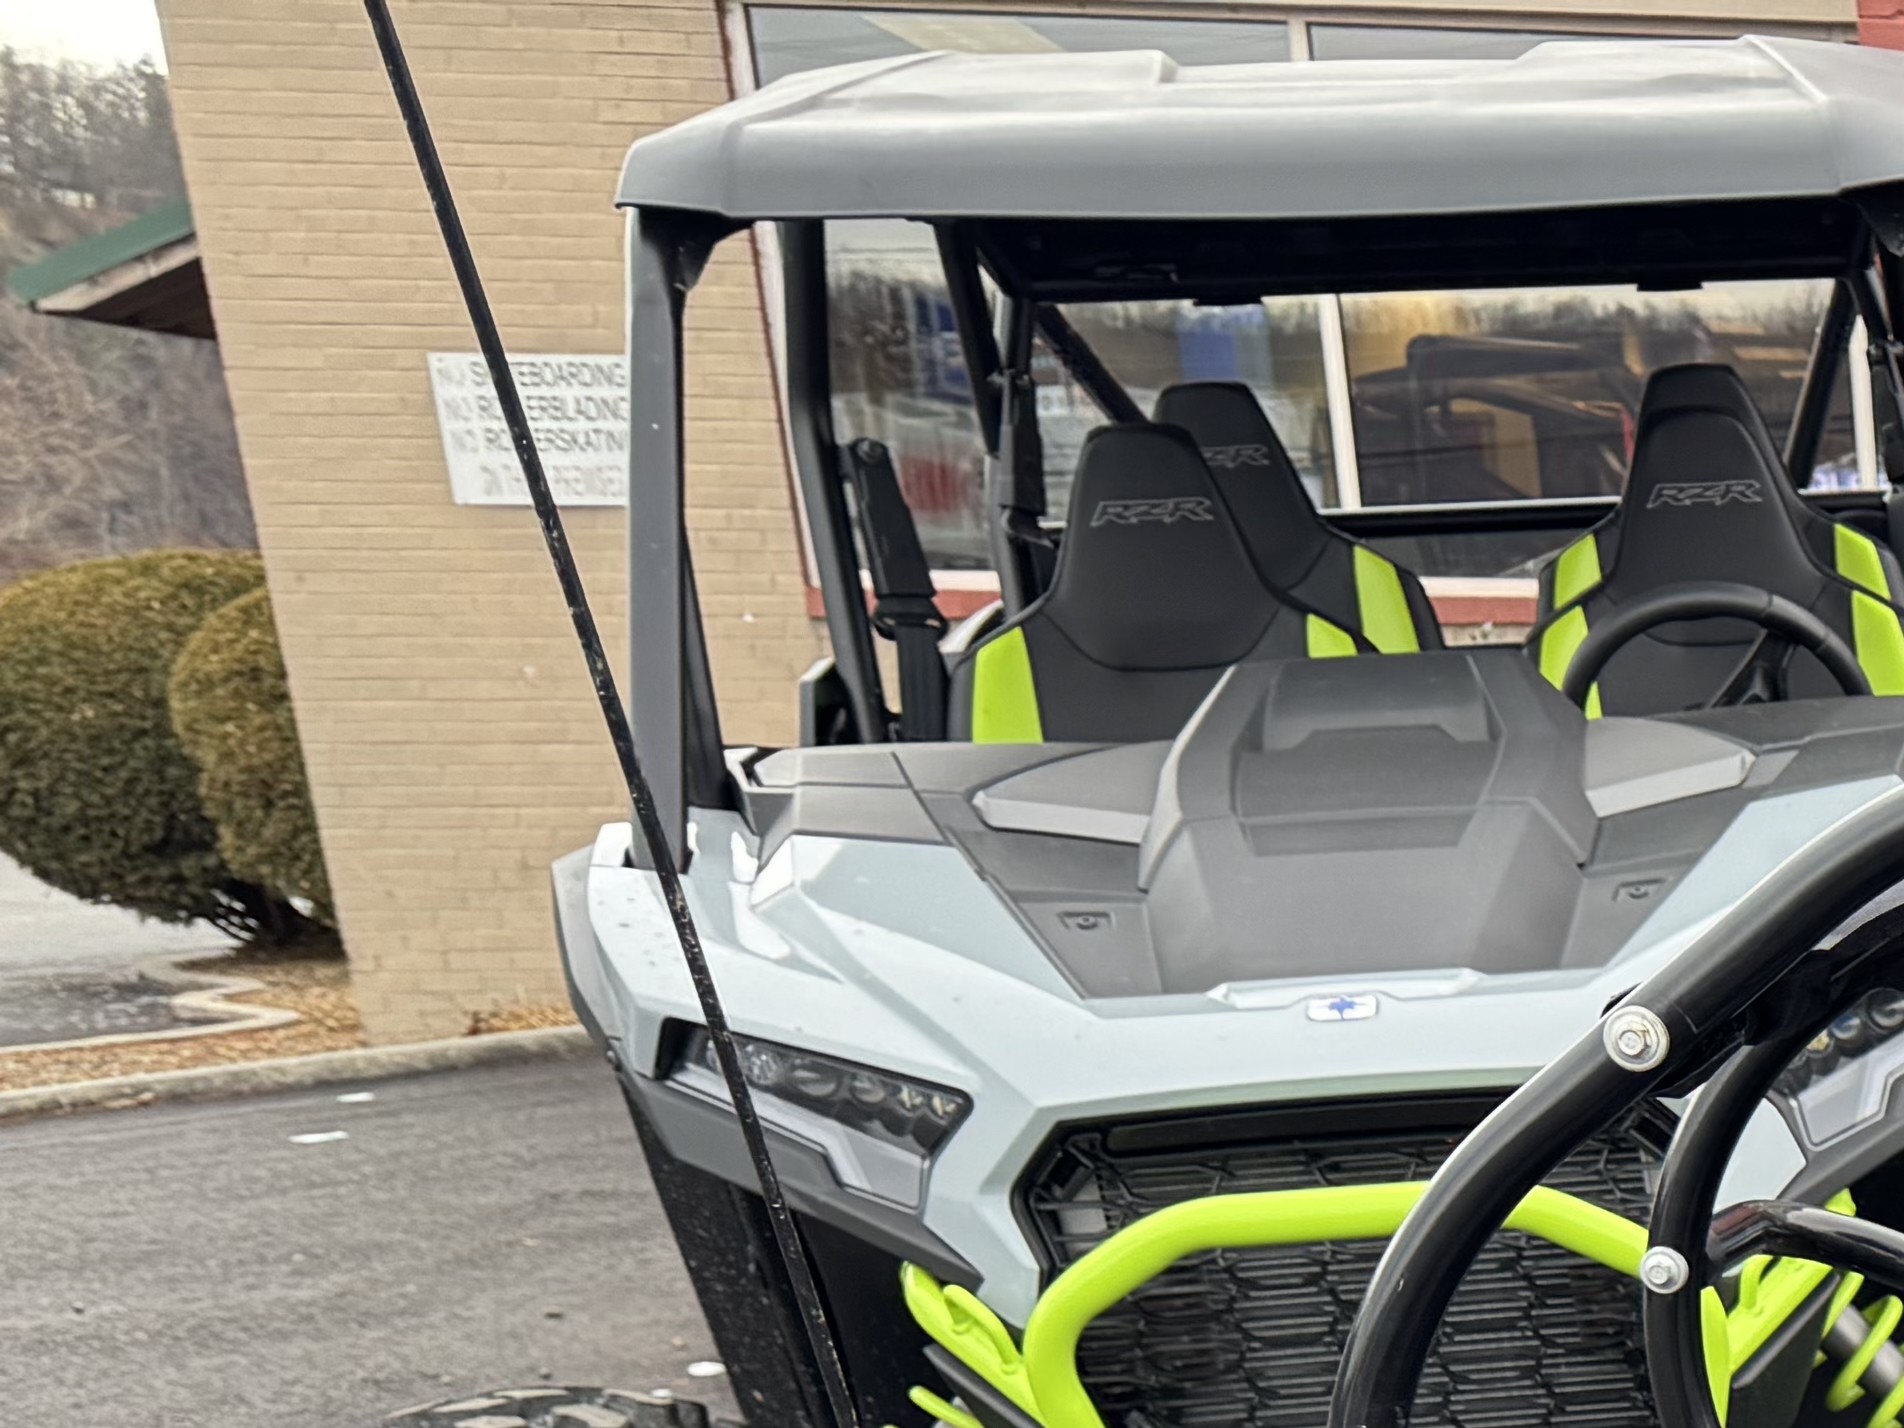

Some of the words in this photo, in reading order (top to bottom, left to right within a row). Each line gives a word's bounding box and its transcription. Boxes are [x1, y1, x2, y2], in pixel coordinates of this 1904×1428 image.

[1201, 444, 1270, 469] ZR
[1646, 480, 1763, 509] RZR
[1090, 497, 1215, 527] RZR
